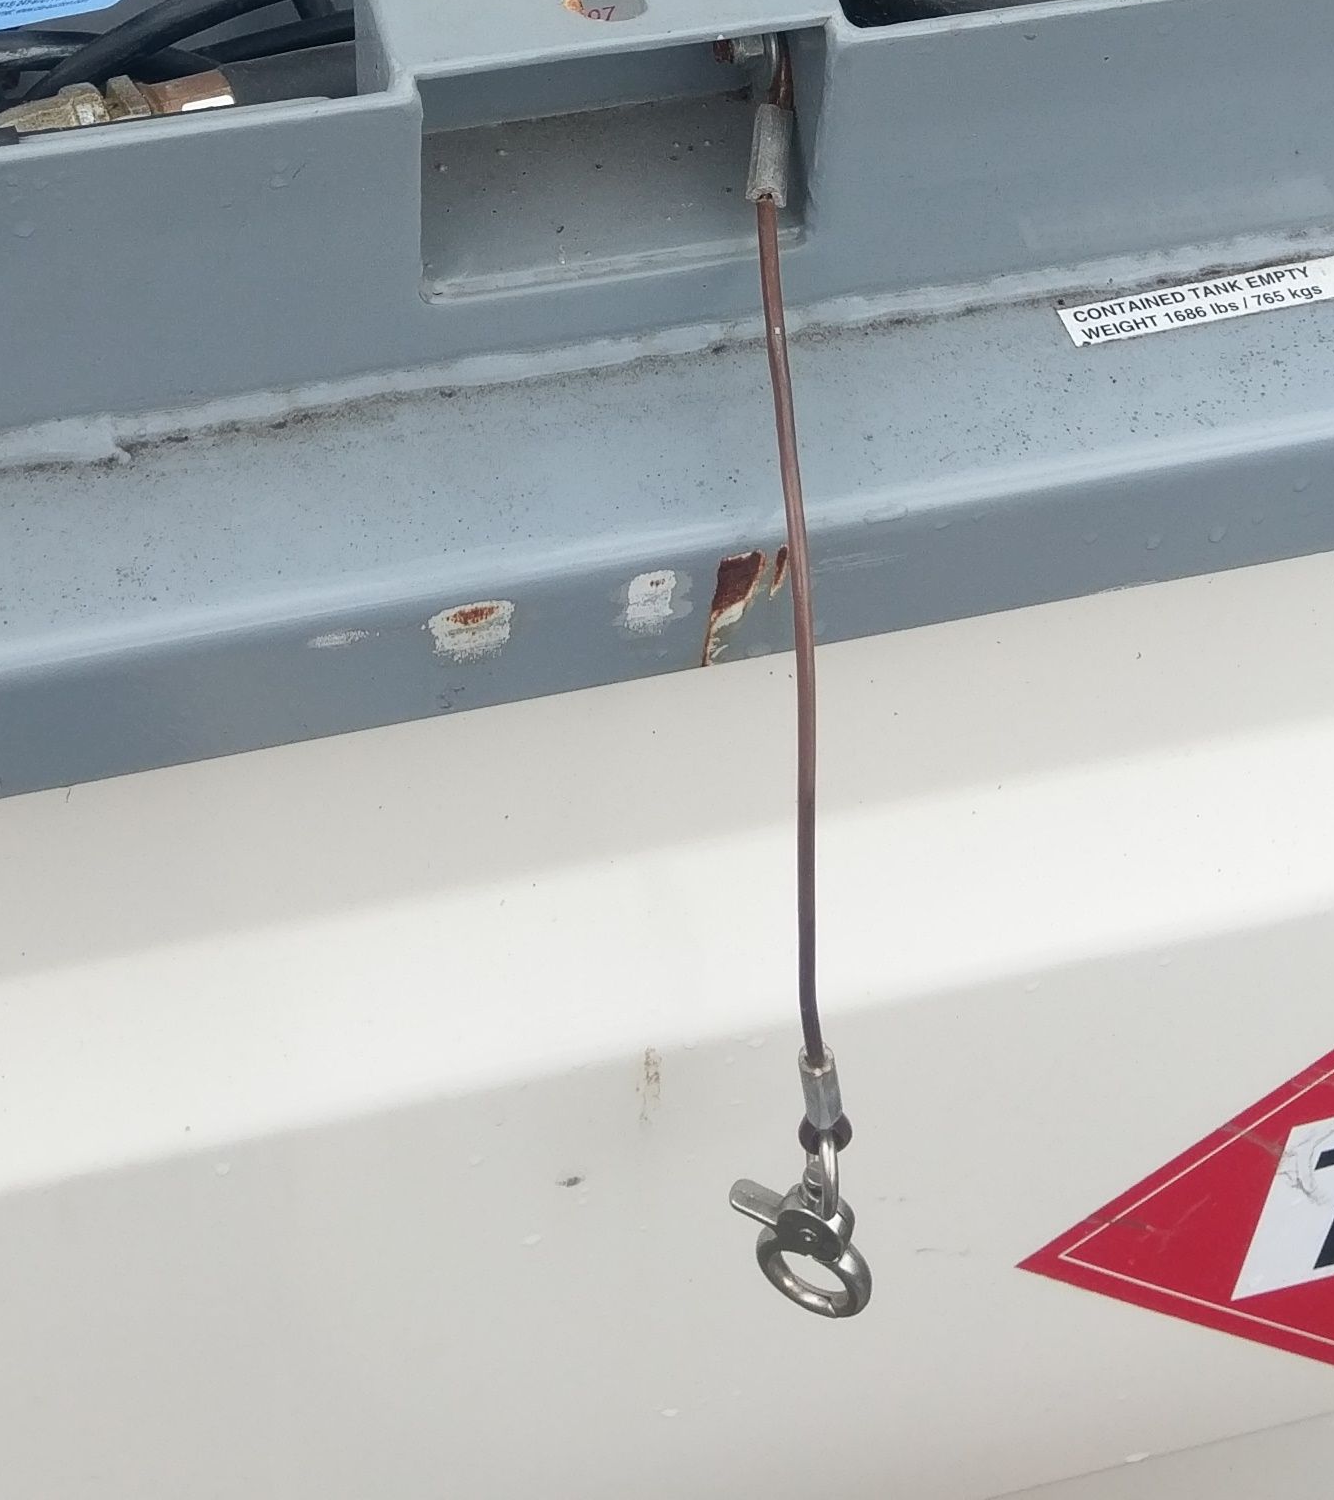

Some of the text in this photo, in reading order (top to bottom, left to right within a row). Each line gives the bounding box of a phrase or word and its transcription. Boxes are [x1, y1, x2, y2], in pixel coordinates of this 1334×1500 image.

[1073, 266, 1311, 323] CONTAINED TANK EMPTY
[1081, 283, 1323, 341] WEIGHT 1686 lbs / 765 kgs
